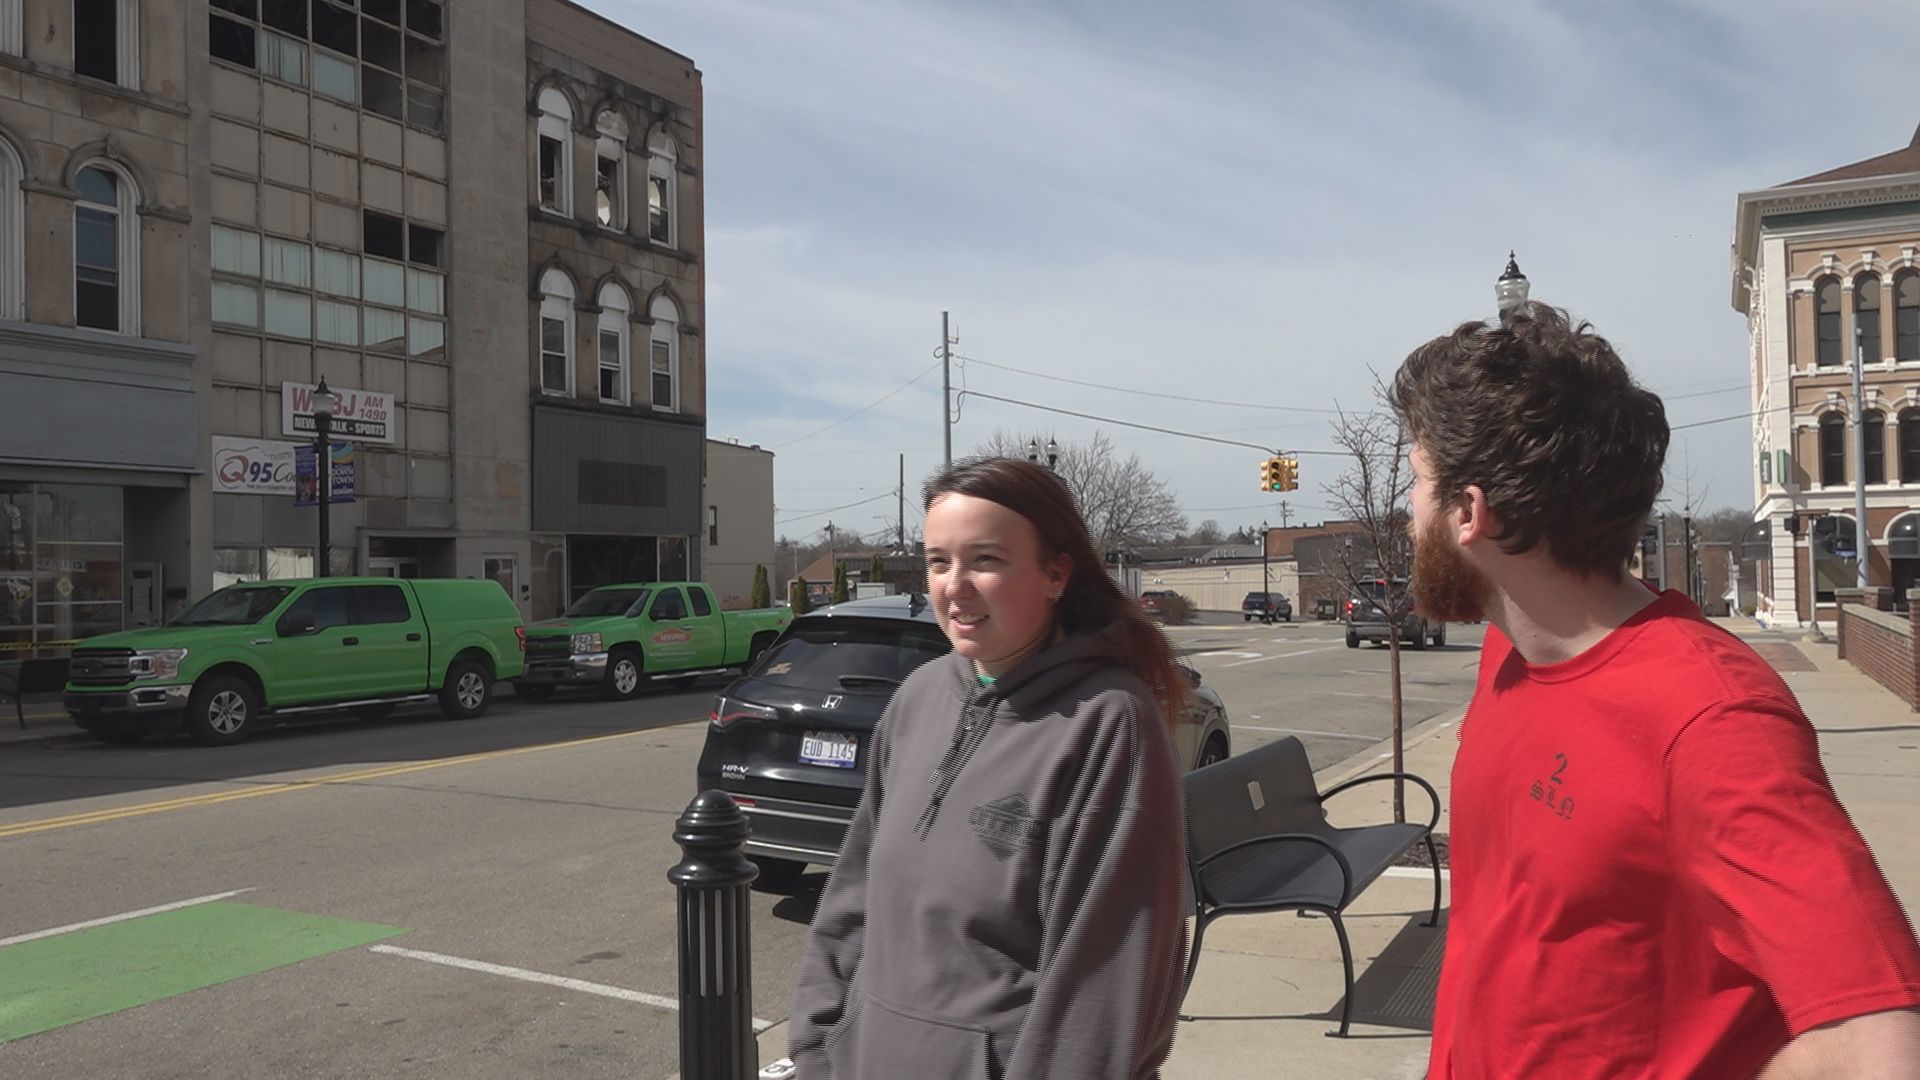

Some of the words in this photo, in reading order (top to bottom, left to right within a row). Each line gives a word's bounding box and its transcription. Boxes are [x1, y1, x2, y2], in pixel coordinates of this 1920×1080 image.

[292, 388, 356, 416] WBJ
[363, 395, 384, 409] AM
[359, 408, 387, 421] 1490
[294, 416, 316, 430] NEW
[355, 423, 385, 436] SPORTS
[331, 476, 354, 485] TOWN
[828, 742, 854, 760] 1145
[721, 764, 749, 774] HR-V
[1550, 752, 1569, 785] 2
